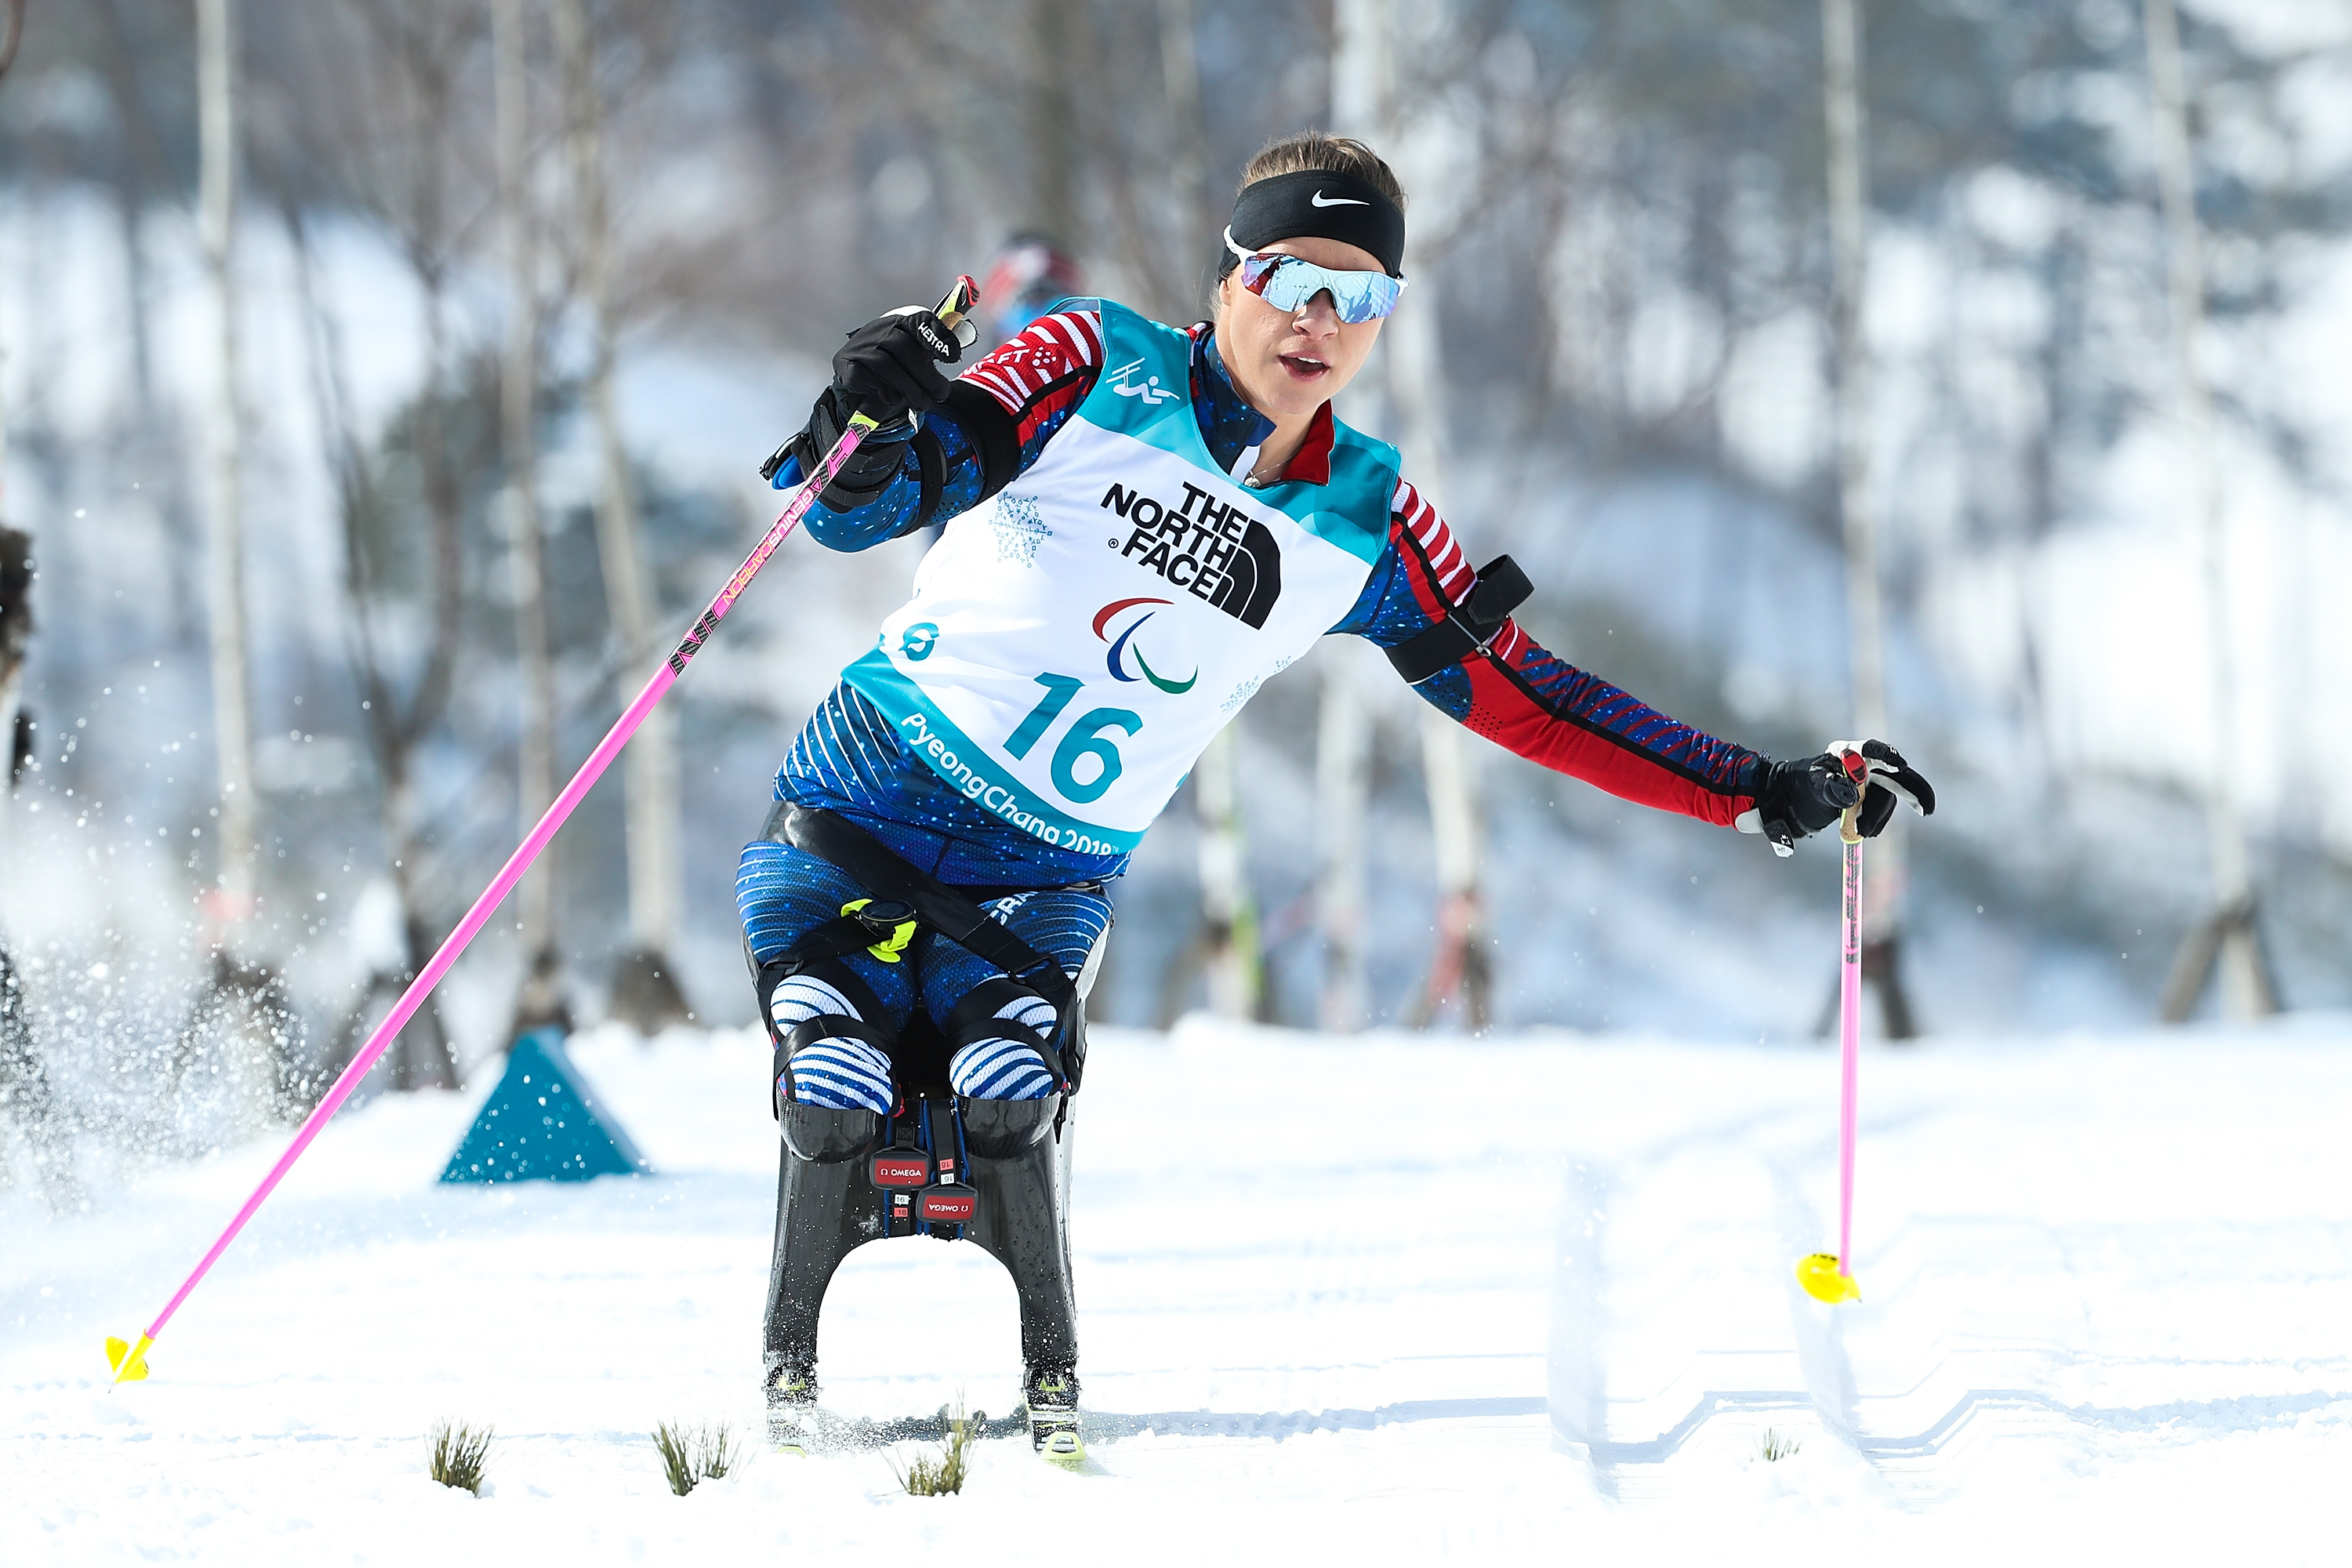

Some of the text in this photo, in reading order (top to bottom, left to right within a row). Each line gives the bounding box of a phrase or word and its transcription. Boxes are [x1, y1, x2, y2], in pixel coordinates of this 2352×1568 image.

[917, 321, 949, 357] HESTRA
[722, 488, 814, 606] GENIUS CARBON
[1100, 482, 1240, 573] NORTH
[1182, 481, 1249, 544] THE
[1121, 528, 1221, 601] FACE
[1002, 671, 1144, 805] 16
[901, 712, 1061, 844] PyeongChang
[890, 1169, 922, 1178] OMEGA
[928, 1203, 959, 1212] OMEGA
